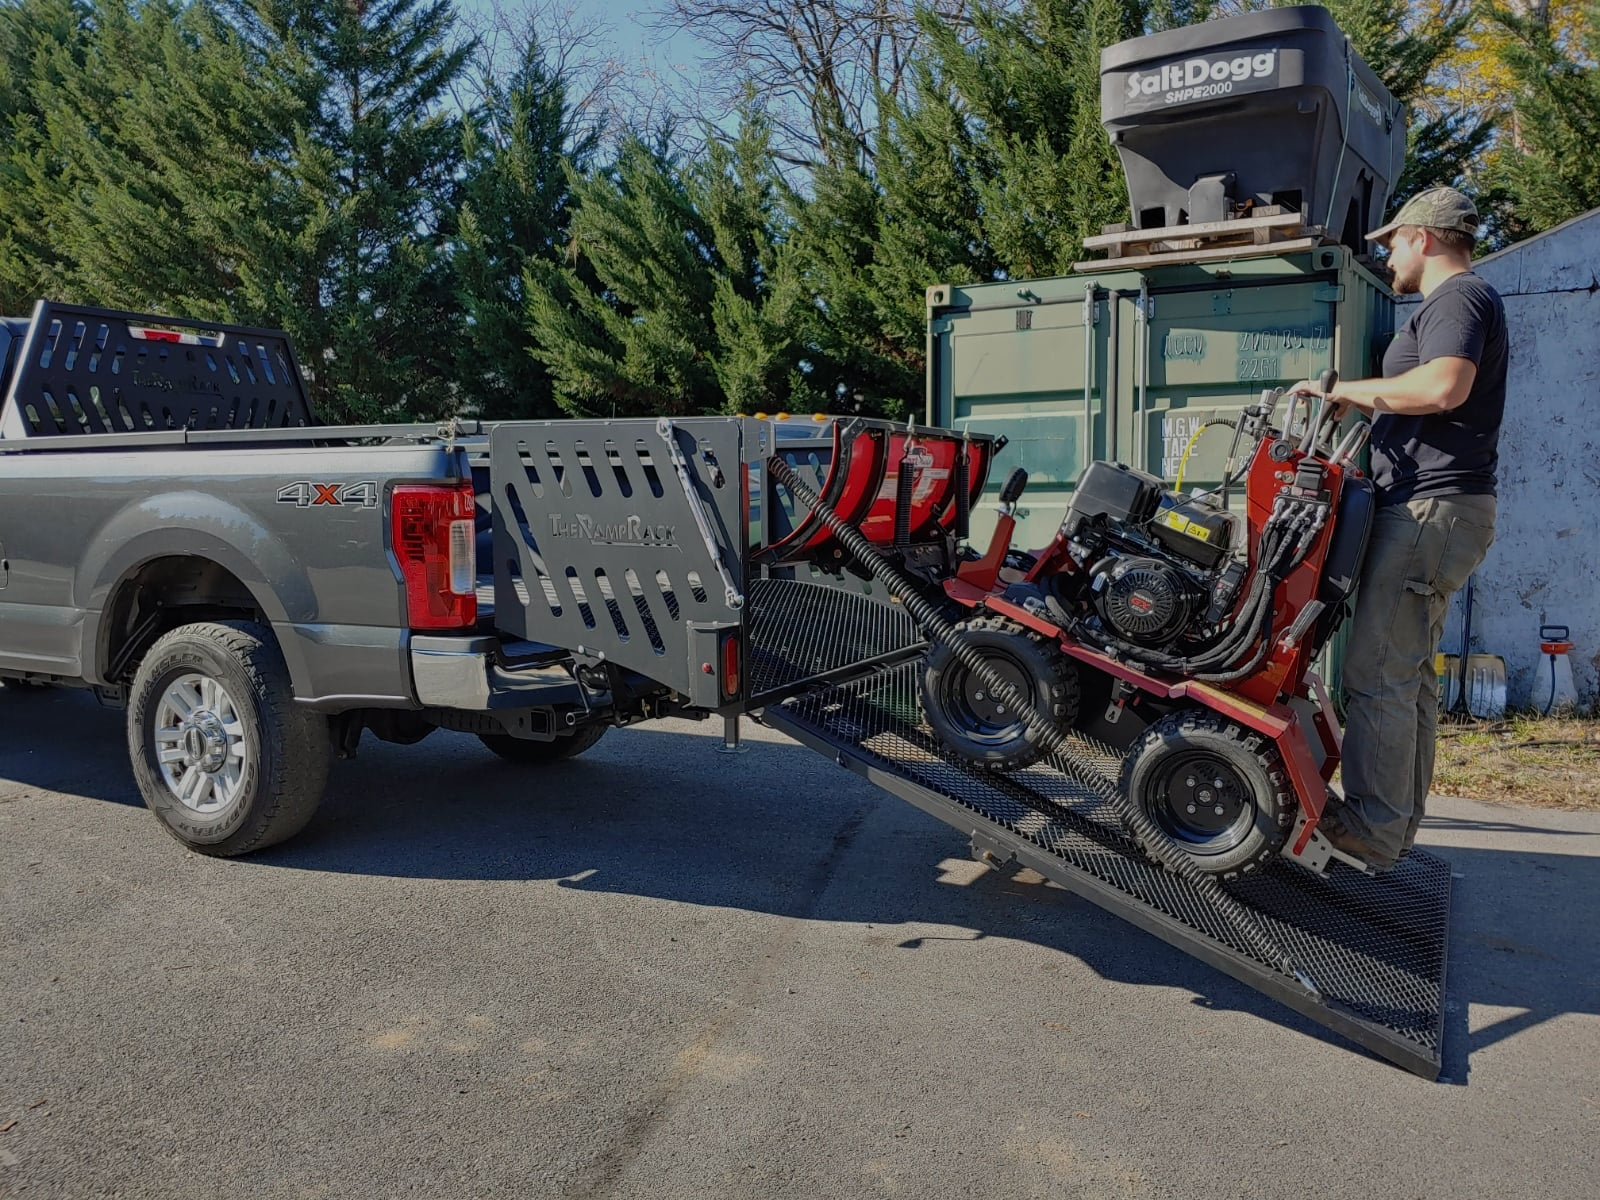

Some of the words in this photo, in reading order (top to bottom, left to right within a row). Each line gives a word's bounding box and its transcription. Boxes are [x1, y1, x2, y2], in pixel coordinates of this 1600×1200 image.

[1127, 51, 1277, 98] SaltDogg
[1164, 81, 1234, 104] SHPE2000
[1161, 437, 1199, 457] TARE
[1161, 457, 1189, 478] NET
